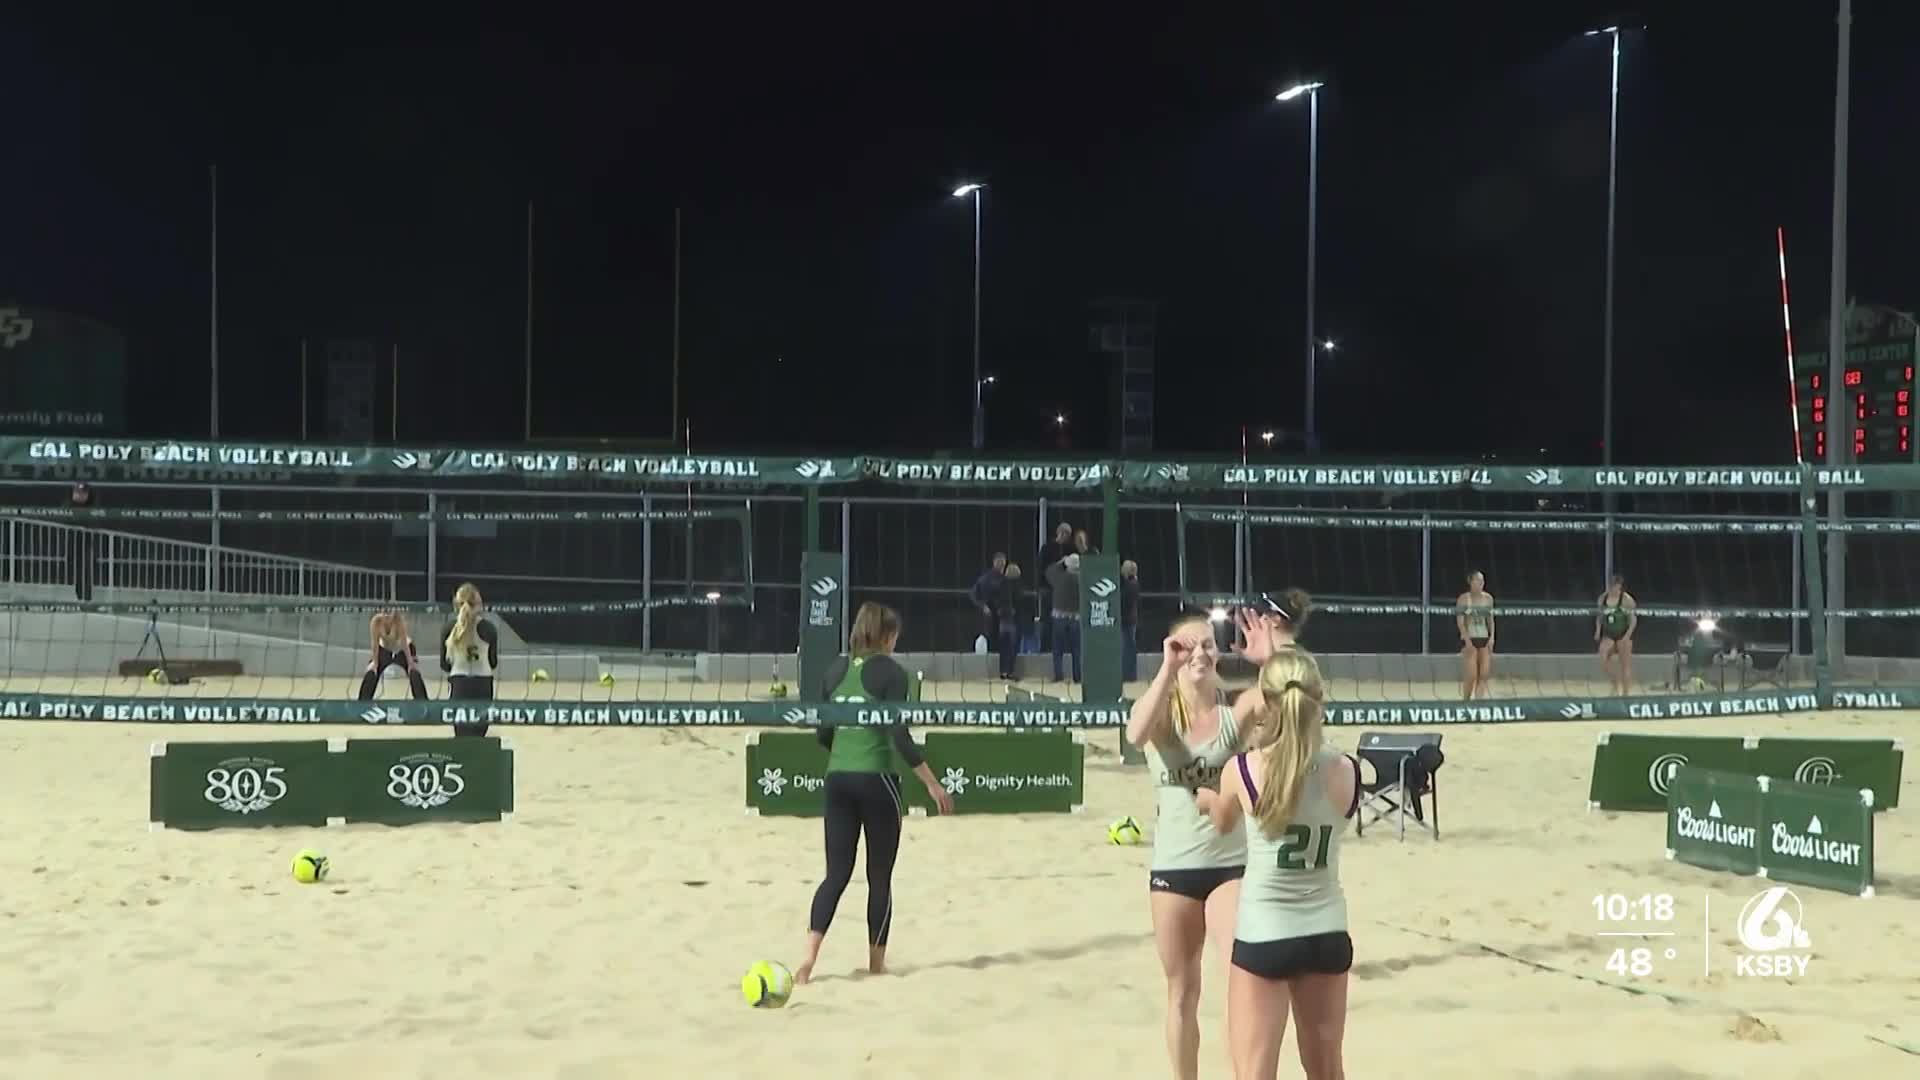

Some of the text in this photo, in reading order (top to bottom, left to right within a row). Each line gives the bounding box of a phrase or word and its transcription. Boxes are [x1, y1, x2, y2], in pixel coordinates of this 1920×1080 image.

[29, 442, 71, 458] CAL
[78, 444, 132, 460] POLY
[218, 447, 353, 466] VOLLEYBALL
[470, 452, 505, 468] CAL
[511, 454, 560, 471] POLY
[633, 456, 759, 478] VOLLEYBALL
[897, 464, 943, 480] POLY
[950, 464, 1011, 481] BEACH
[1223, 468, 1492, 486] CAL POLY BEACH VOLLEYBALL
[1595, 470, 1628, 485] CAL
[1634, 471, 1680, 486] POLY
[1685, 471, 1743, 486] BEACH
[0, 701, 320, 722] AL POLY BEACH VOLLEYBALL
[441, 707, 745, 724] CAL POLY BEACH VOLLEYBALL
[857, 710, 893, 724] CAL
[900, 710, 947, 724] POLY
[953, 708, 1016, 725] BEACH
[1342, 708, 1402, 723] BEACH
[1408, 706, 1526, 722] VOLLEYBALL
[1629, 703, 1664, 718] CAL
[1670, 701, 1713, 717] POLY
[1720, 697, 1780, 715] BEACH
[204, 766, 288, 803] 805
[387, 762, 465, 799] 805
[975, 774, 1073, 791] Dignity Health.
[1276, 824, 1333, 870] 21
